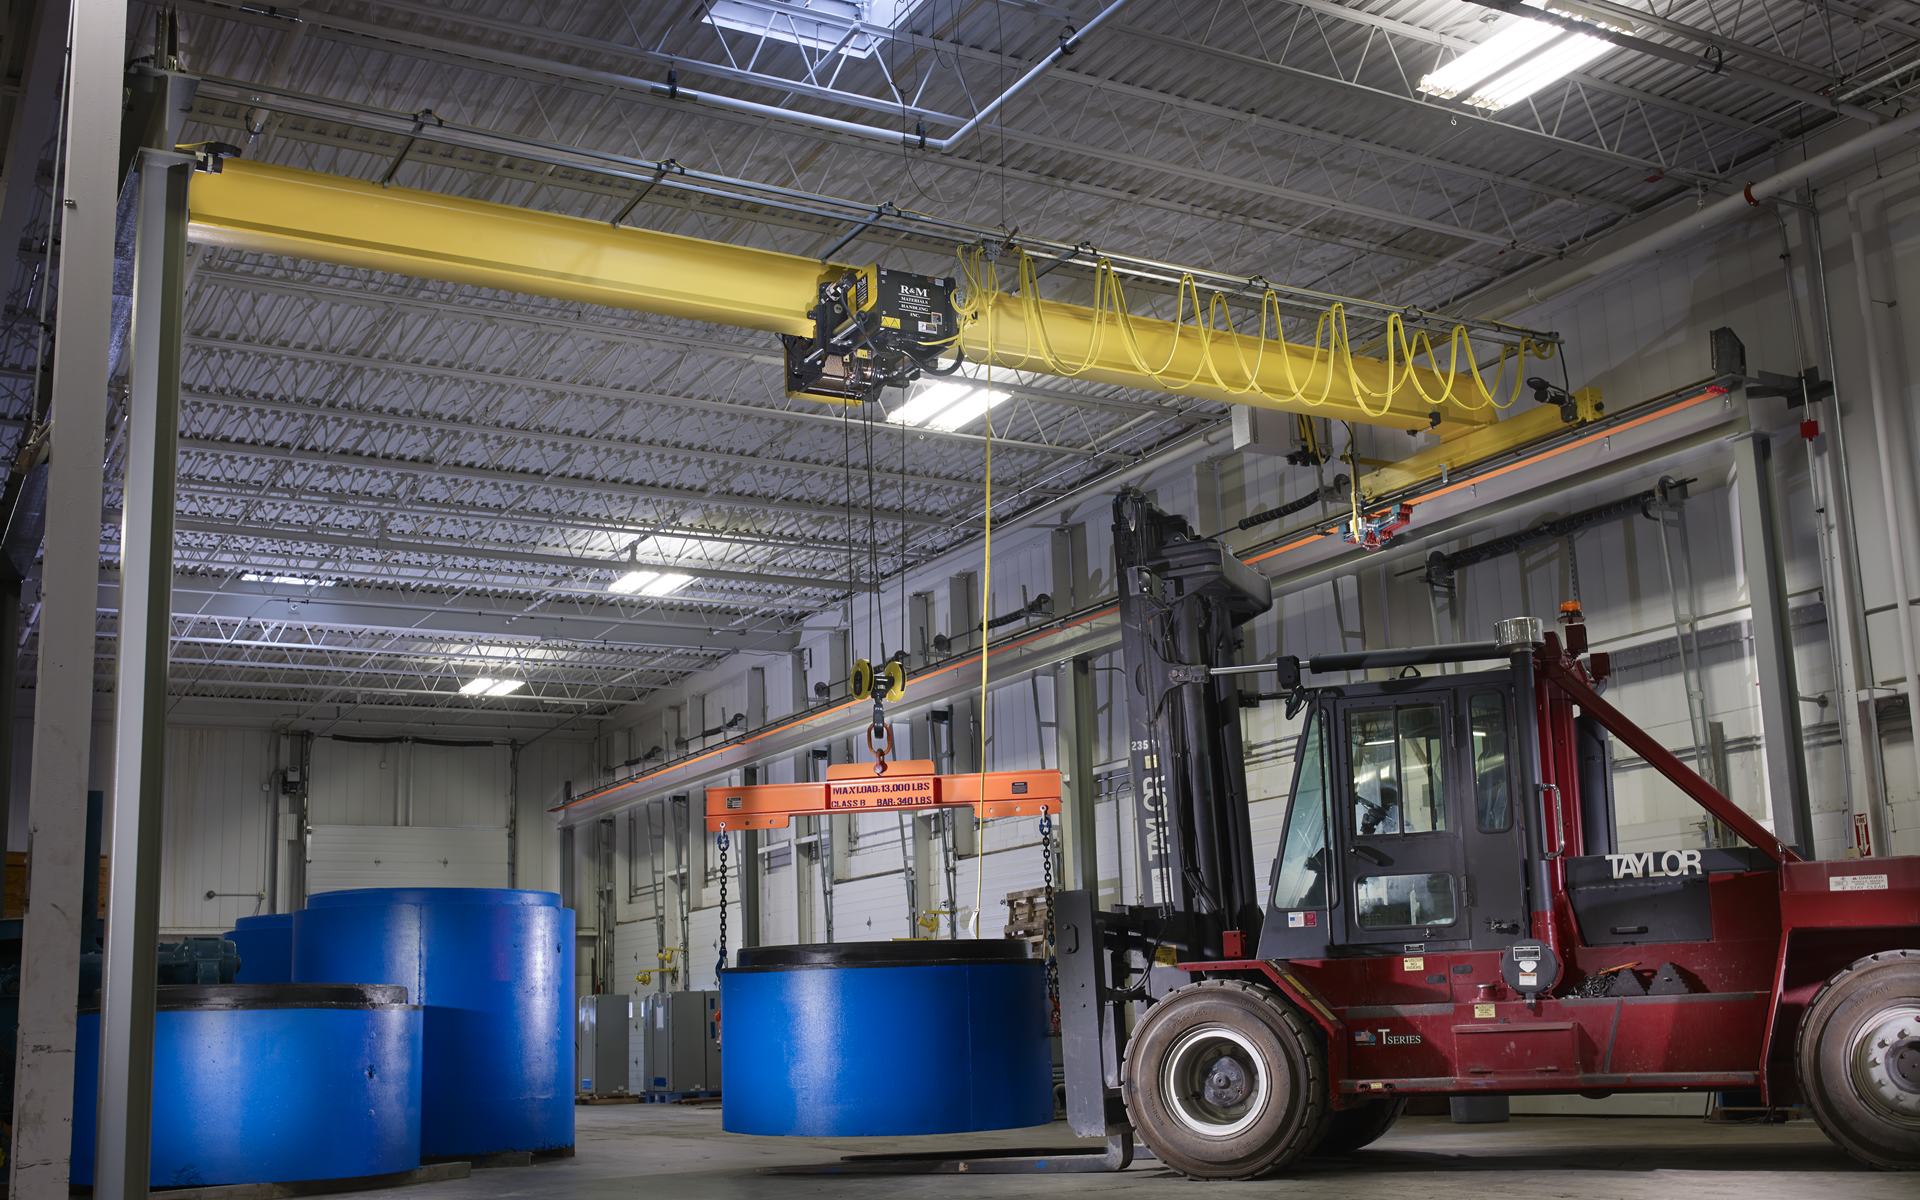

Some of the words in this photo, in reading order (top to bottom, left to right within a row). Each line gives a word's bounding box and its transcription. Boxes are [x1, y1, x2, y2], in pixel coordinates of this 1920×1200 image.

[900, 284, 928, 298] R&M
[901, 296, 929, 305] MATERIALS
[901, 304, 929, 312] HANDLING
[912, 782, 930, 791] LBS
[831, 799, 858, 808] CLASS
[897, 797, 913, 805] 340
[915, 796, 932, 804] LBS
[1605, 849, 1703, 879] TAYLOR
